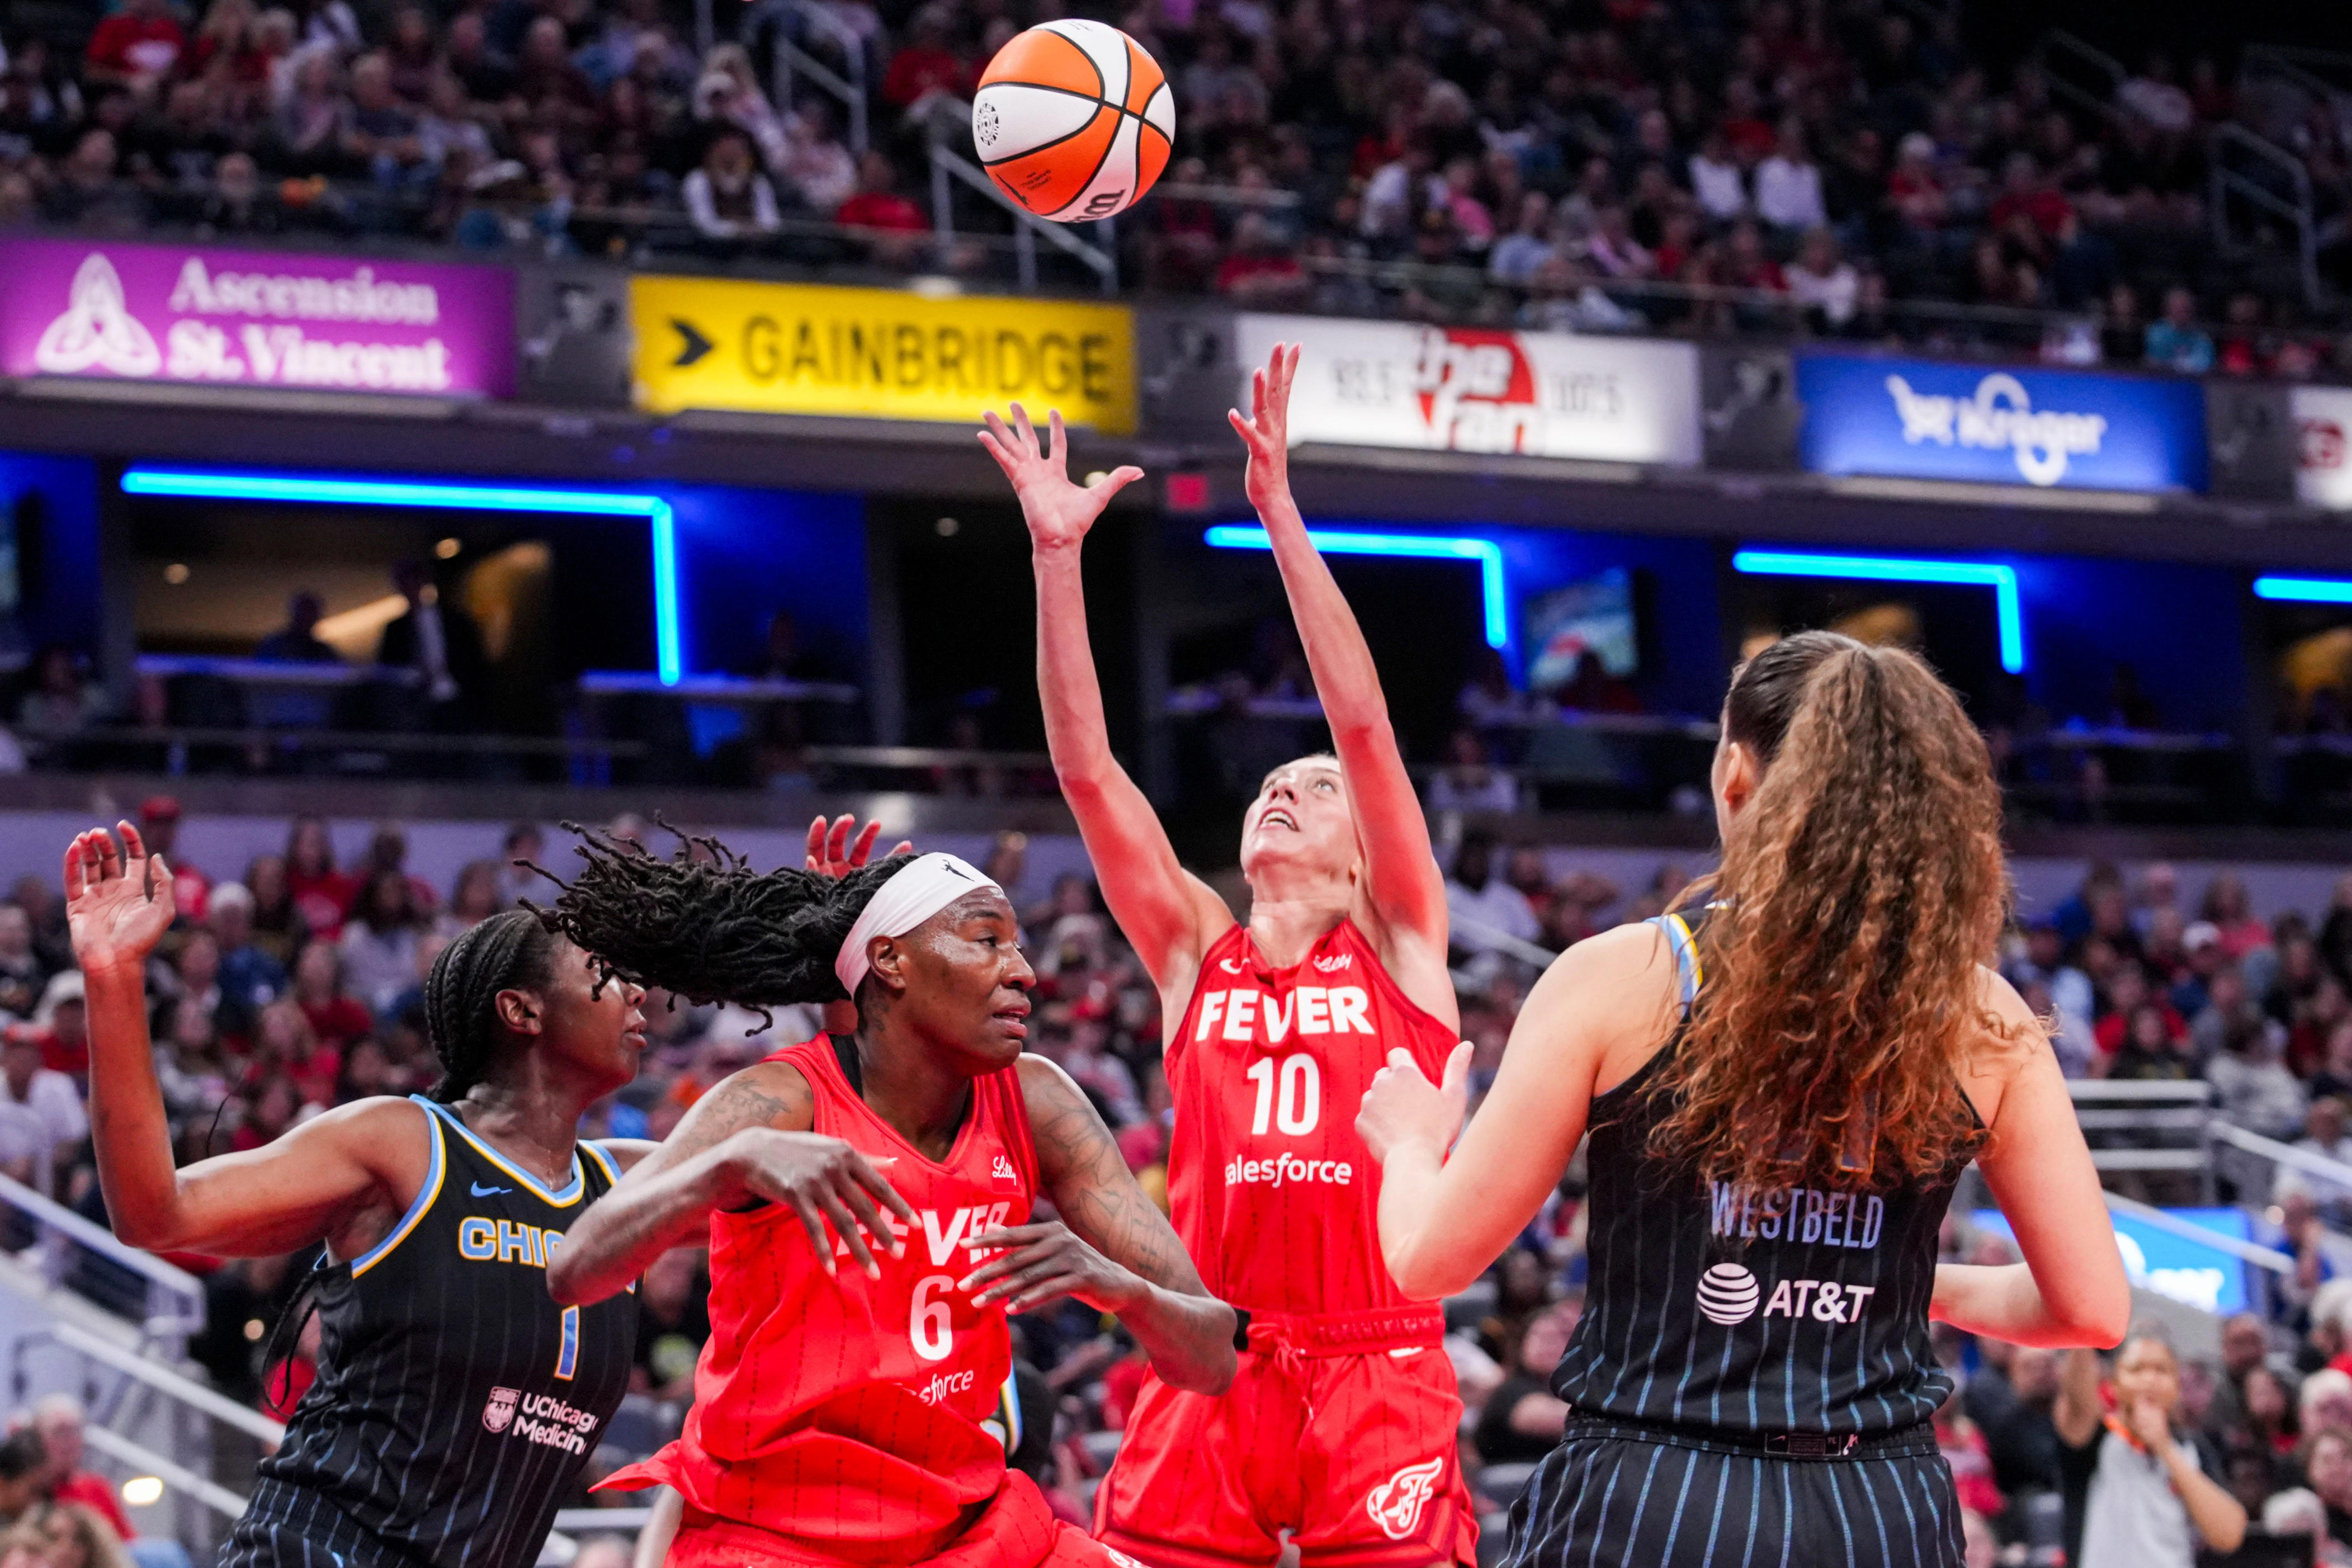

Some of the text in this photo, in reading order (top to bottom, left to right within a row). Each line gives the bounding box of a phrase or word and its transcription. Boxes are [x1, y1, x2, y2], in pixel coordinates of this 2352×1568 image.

[170, 257, 439, 325] Ascension
[167, 319, 448, 390] St. Vincent
[740, 315, 1111, 401] GAINBRIDGE
[1958, 372, 2107, 485] Kroger
[1196, 985, 1376, 1043] FEVER
[1247, 1052, 1320, 1137] 10
[992, 1155, 1017, 1186] Lilly
[1225, 1152, 1352, 1188] alesforce
[1712, 1180, 1885, 1249] WESTBELD
[910, 1275, 955, 1361] 6
[1763, 1279, 1875, 1324] AT&T
